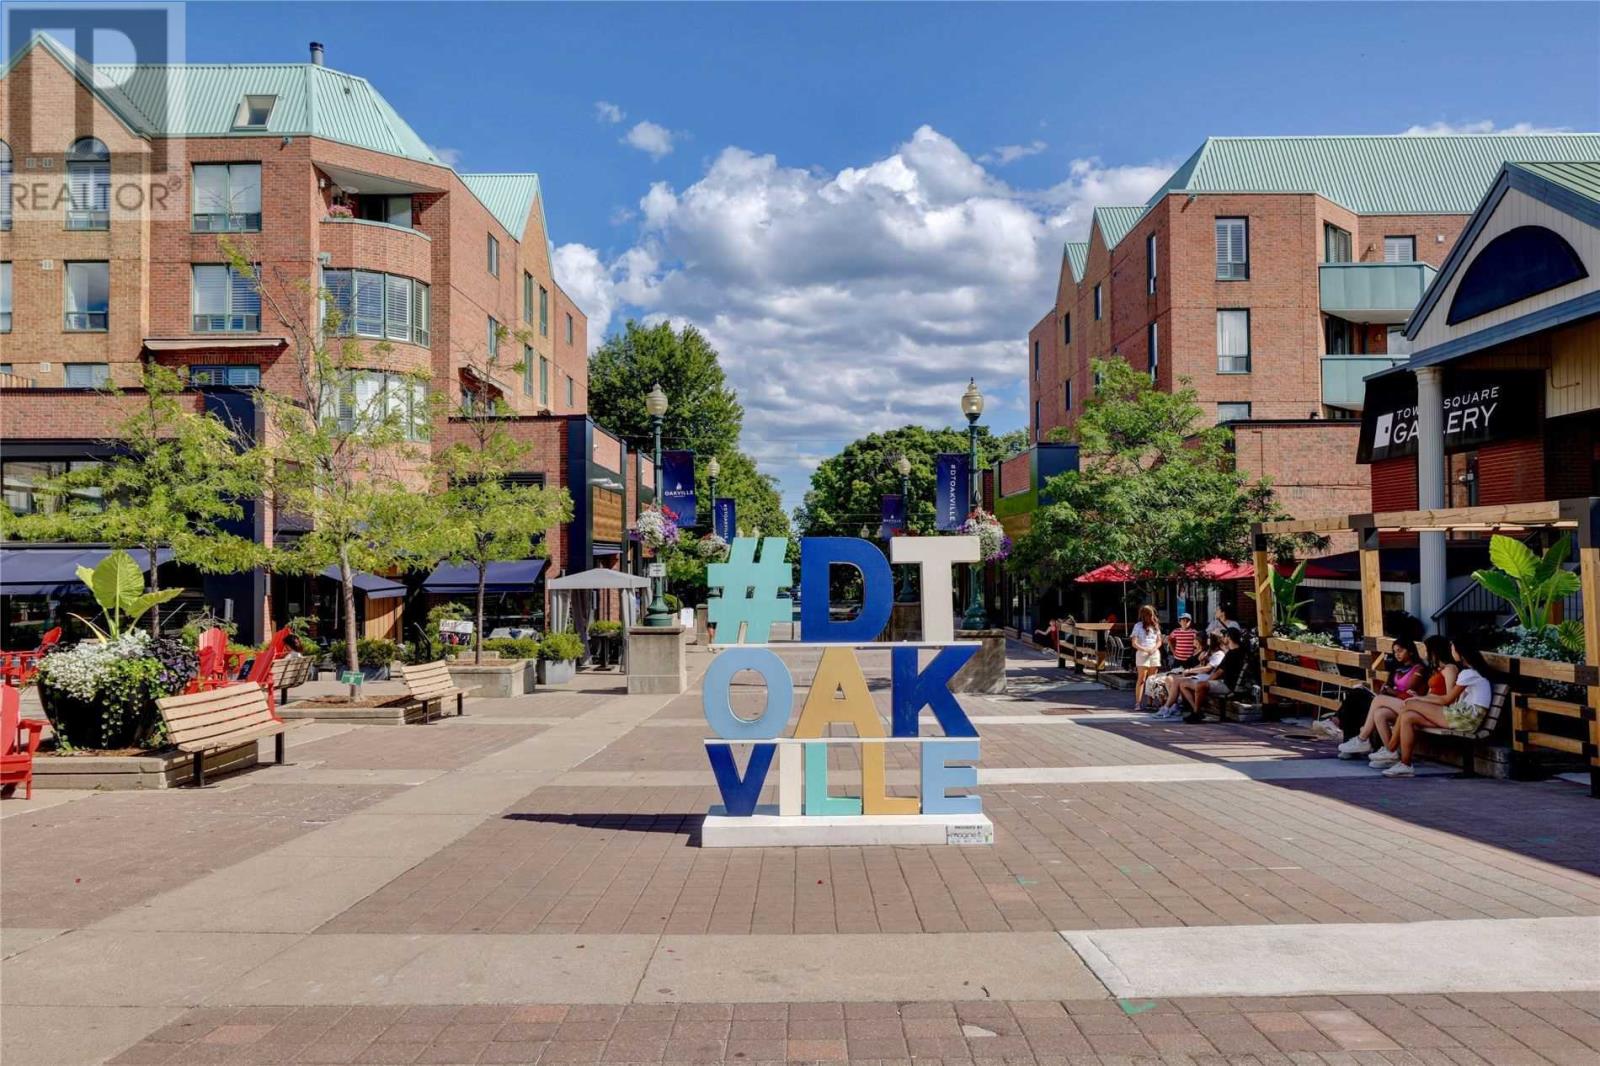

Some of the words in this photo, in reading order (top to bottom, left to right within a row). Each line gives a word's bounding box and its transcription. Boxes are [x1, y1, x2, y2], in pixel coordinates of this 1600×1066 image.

[1393, 402, 1498, 444] GAERY
[1396, 405, 1420, 420] TOW
[1443, 386, 1500, 409] SQUARE
[949, 464, 957, 521] #DTOAKVILLE
[707, 536, 981, 643] #DT
[703, 646, 982, 739] OAK
[704, 742, 983, 817] VILLE
